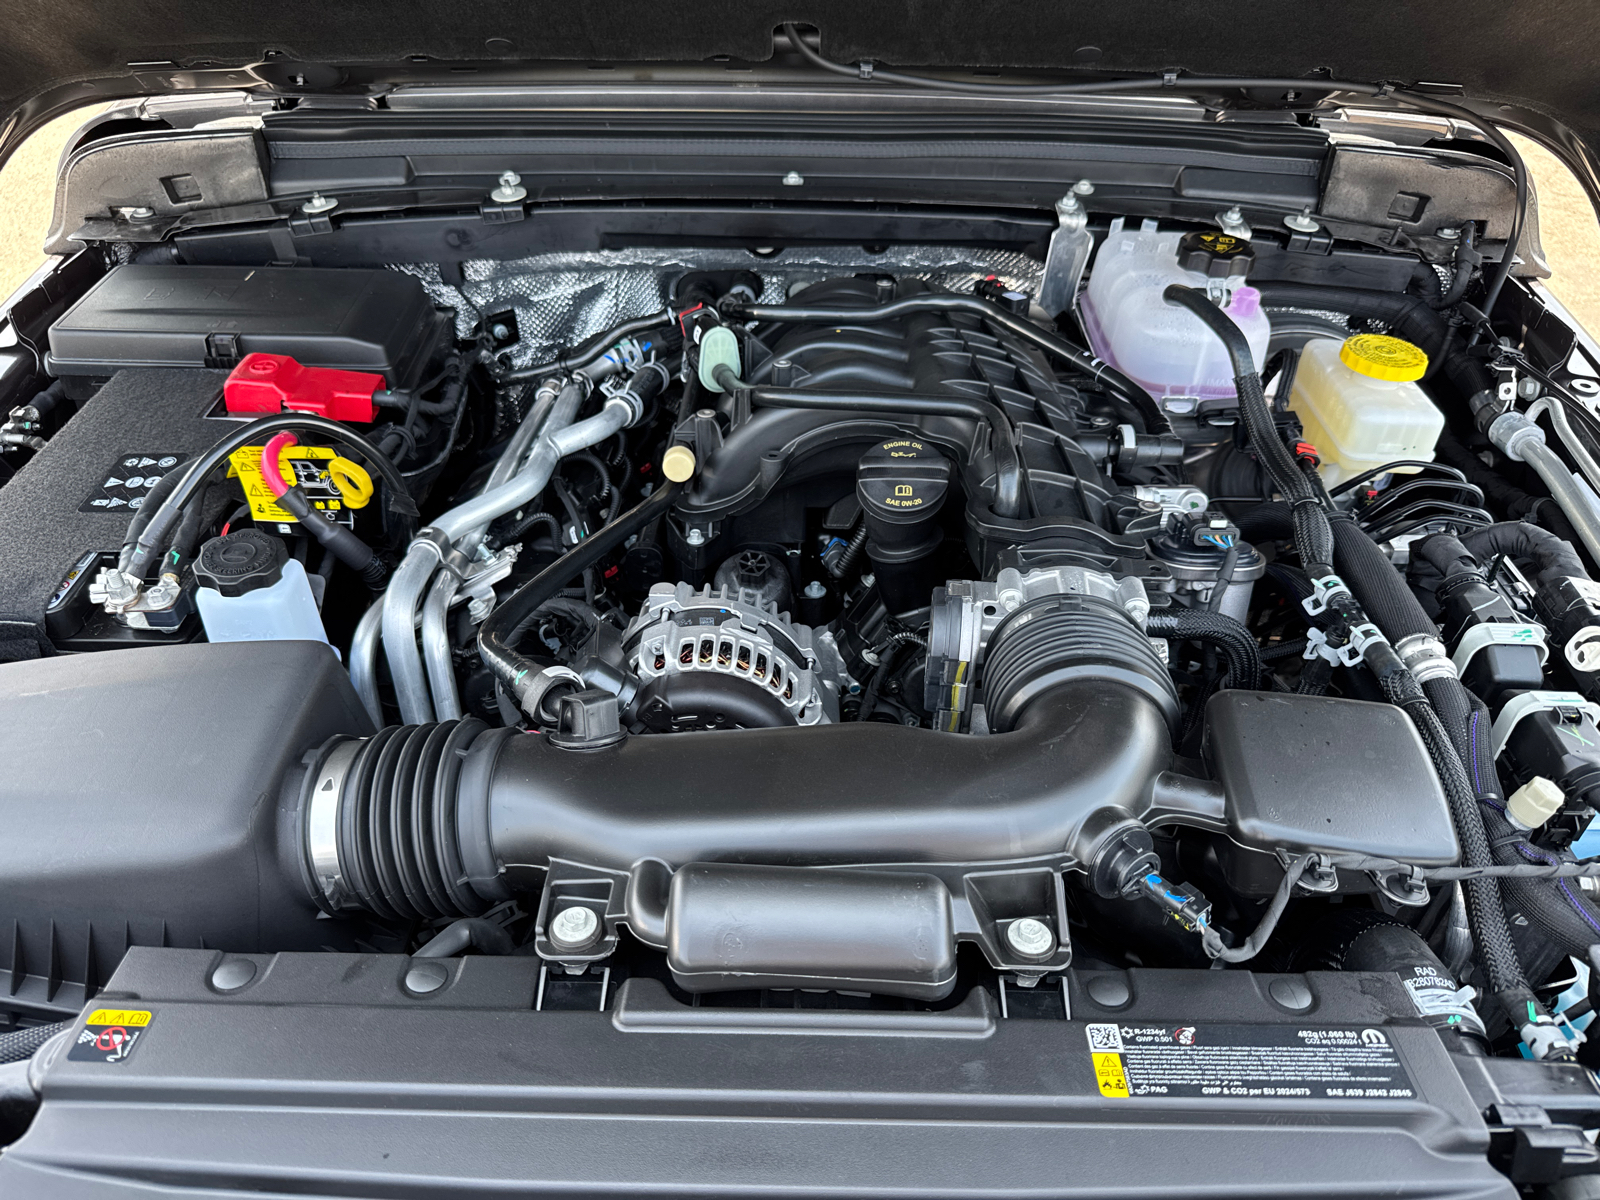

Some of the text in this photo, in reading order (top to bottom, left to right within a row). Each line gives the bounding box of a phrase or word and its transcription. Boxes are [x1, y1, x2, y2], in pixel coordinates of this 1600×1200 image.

[883, 440, 924, 451] ENGINE OIL
[885, 497, 923, 507] SAE 0W-20
[1413, 966, 1438, 976] RAD
[1201, 1086, 1222, 1095] GWP
[1230, 1087, 1248, 1095] CO2
[1262, 1087, 1275, 1096] EU
[1326, 1088, 1344, 1097] SAE
